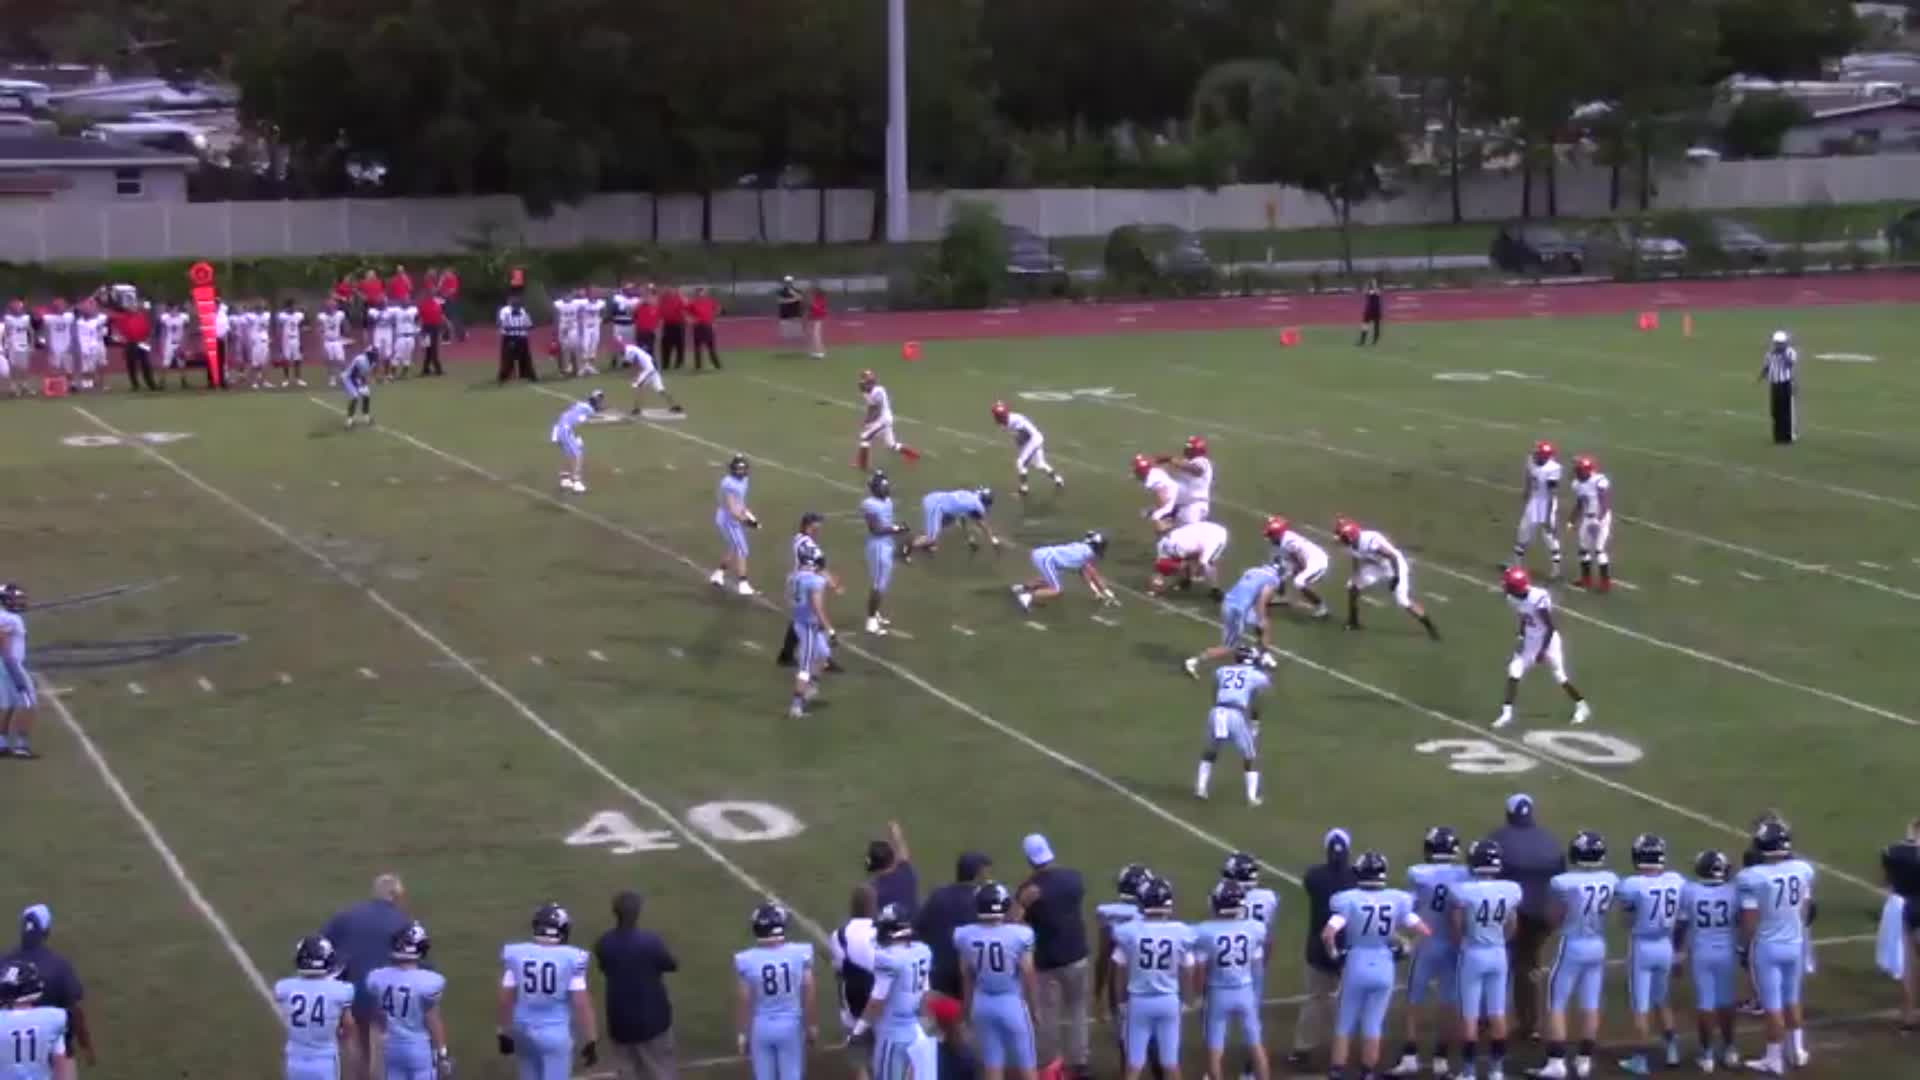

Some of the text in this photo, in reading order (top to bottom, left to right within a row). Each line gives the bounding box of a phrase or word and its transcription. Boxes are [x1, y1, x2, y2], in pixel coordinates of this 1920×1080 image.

[1223, 670, 1245, 689] 25
[1415, 730, 1644, 774] 30
[563, 801, 806, 854] 40
[1583, 884, 1611, 916] 72
[1649, 888, 1677, 920] 76
[1773, 875, 1800, 909] 78
[1361, 906, 1392, 937] 75
[1475, 898, 1506, 927] 44
[1697, 900, 1729, 928] 53
[973, 941, 1004, 973] 70
[1139, 938, 1172, 970] 52
[1217, 935, 1248, 967] 23
[523, 961, 557, 995] 50
[761, 961, 793, 996] 81
[290, 994, 326, 1028] 24
[381, 985, 412, 1018] 47
[11, 1029, 37, 1063] 11
